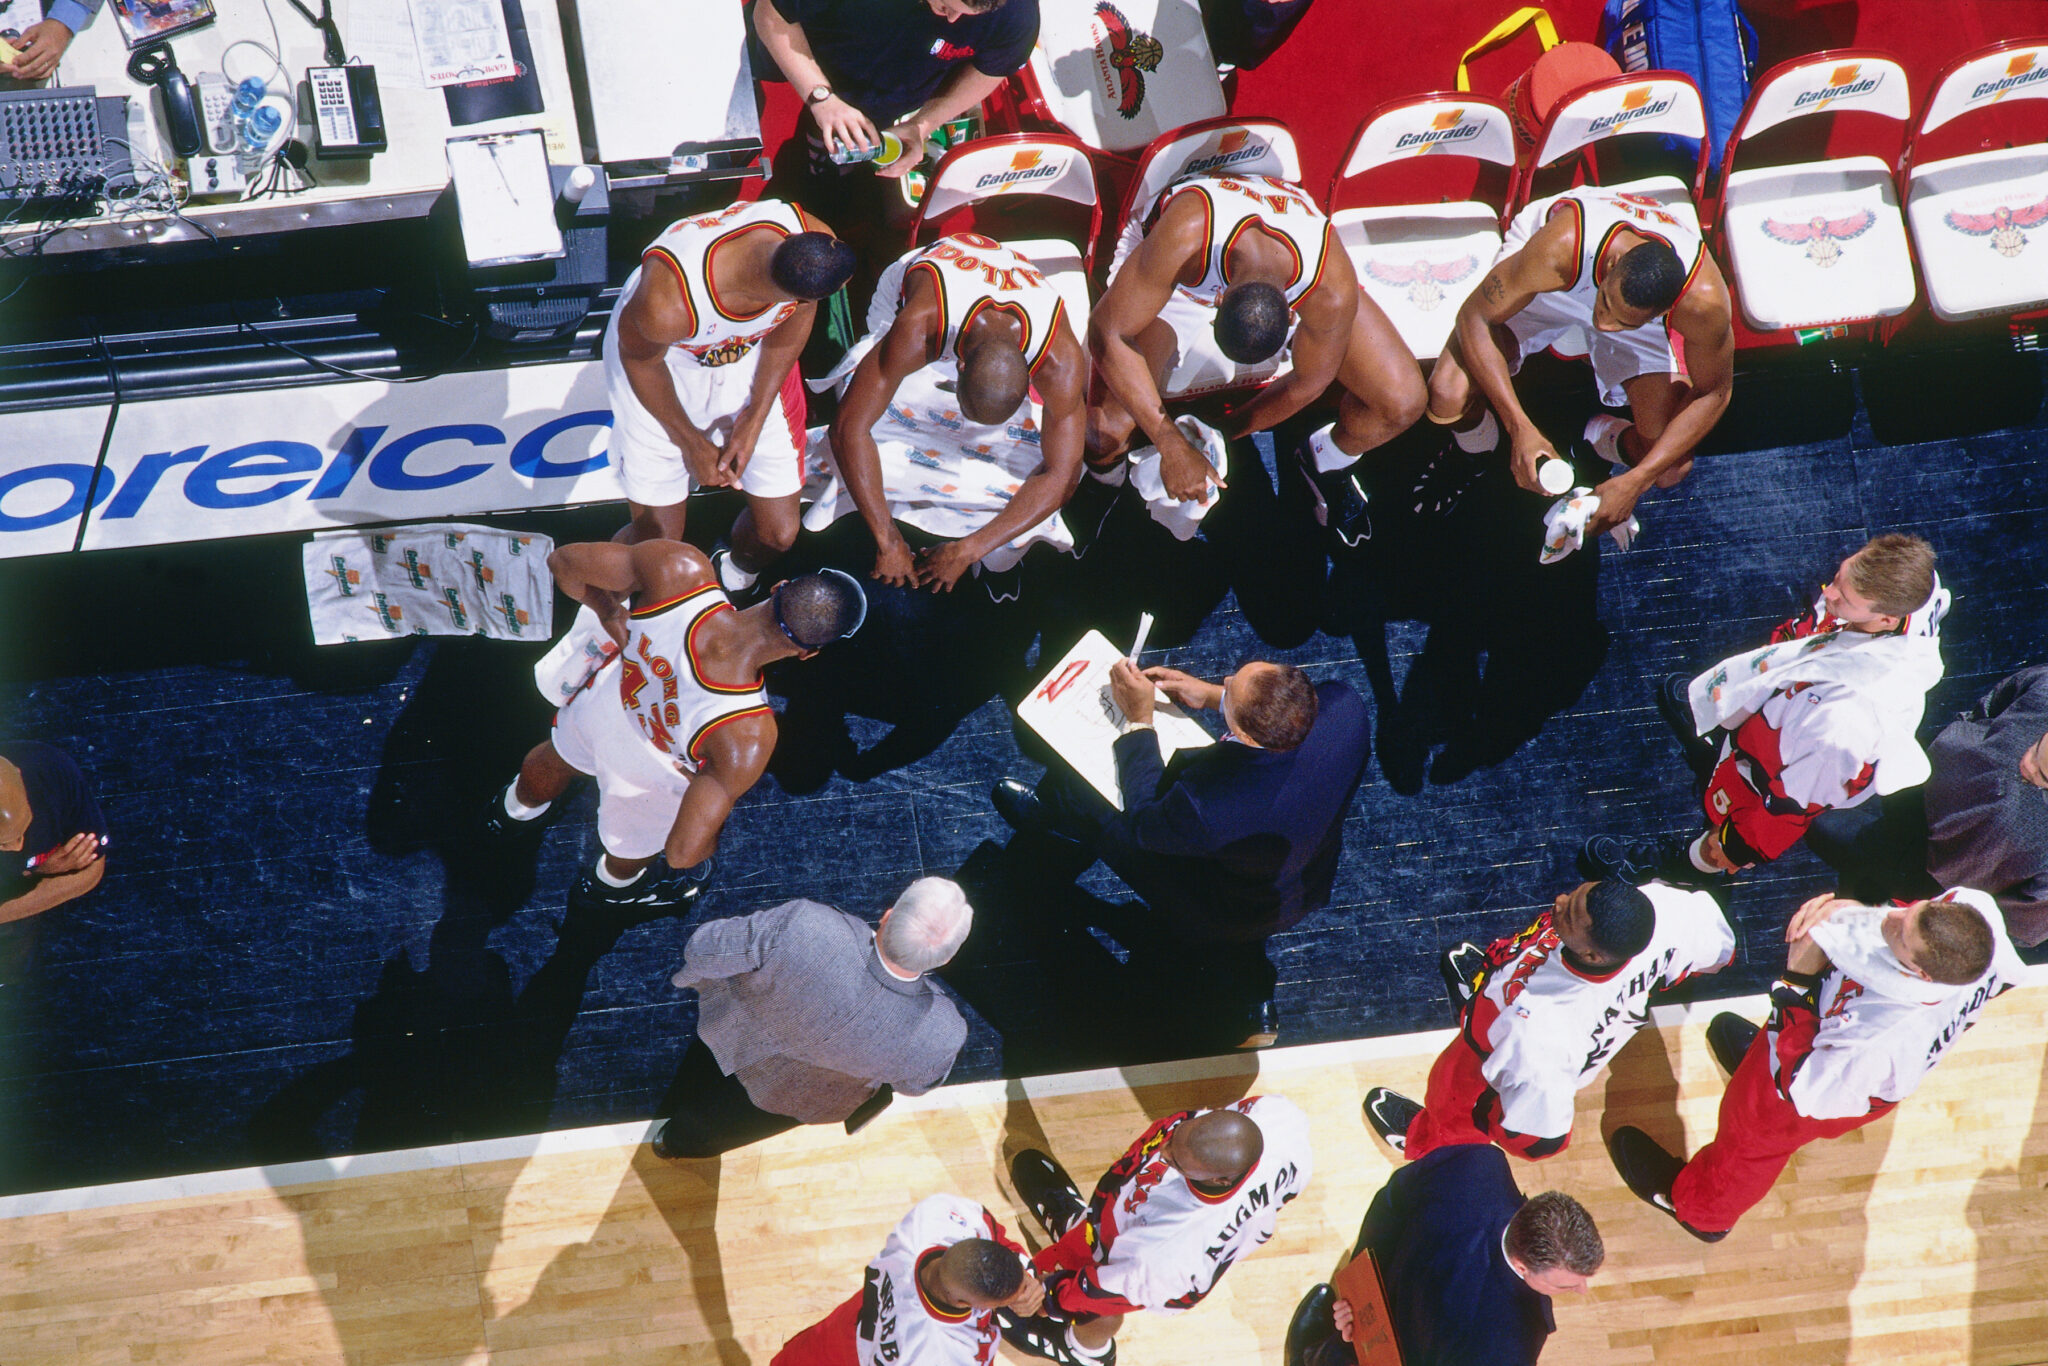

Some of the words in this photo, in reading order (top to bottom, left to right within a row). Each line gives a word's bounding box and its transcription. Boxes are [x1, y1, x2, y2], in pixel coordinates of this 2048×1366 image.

[1793, 79, 1875, 107] Gatorade
[1588, 98, 1668, 132] Gatorade
[1395, 124, 1478, 149] Gatorade
[1183, 145, 1265, 175] Gatorade
[976, 164, 1058, 189] Gatorade
[637, 633, 681, 728] LONG
